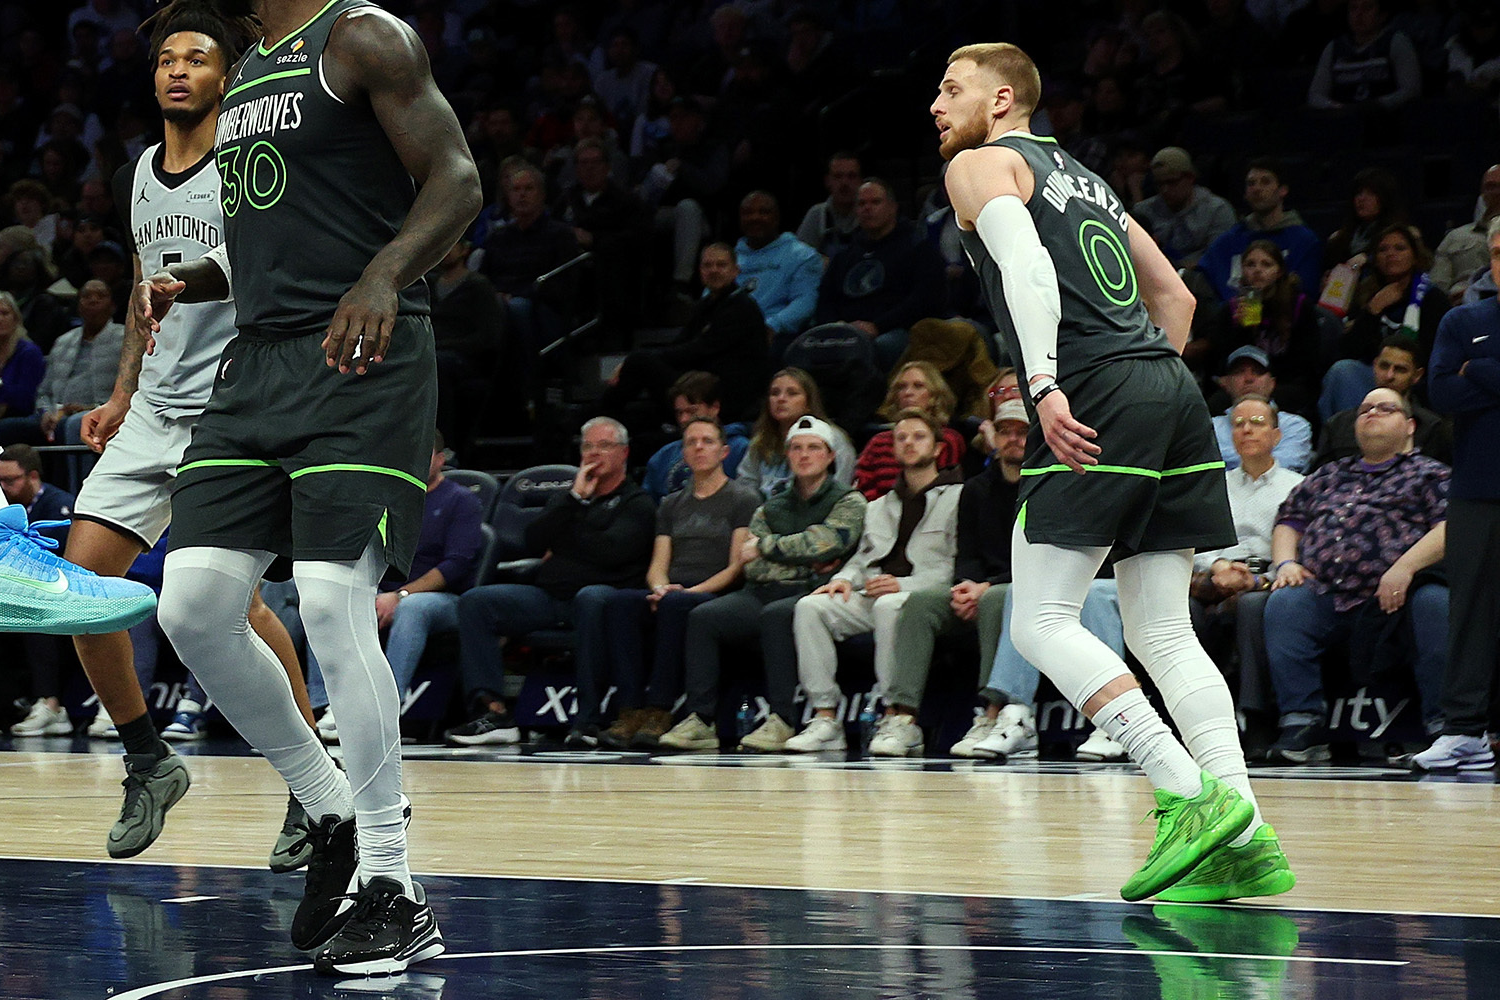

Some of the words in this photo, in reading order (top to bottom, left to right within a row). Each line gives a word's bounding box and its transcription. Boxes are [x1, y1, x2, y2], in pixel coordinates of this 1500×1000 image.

[276, 52, 308, 65] sezzle
[217, 140, 287, 218] 30
[156, 214, 219, 249] ANTONIO
[1078, 219, 1139, 307] 0
